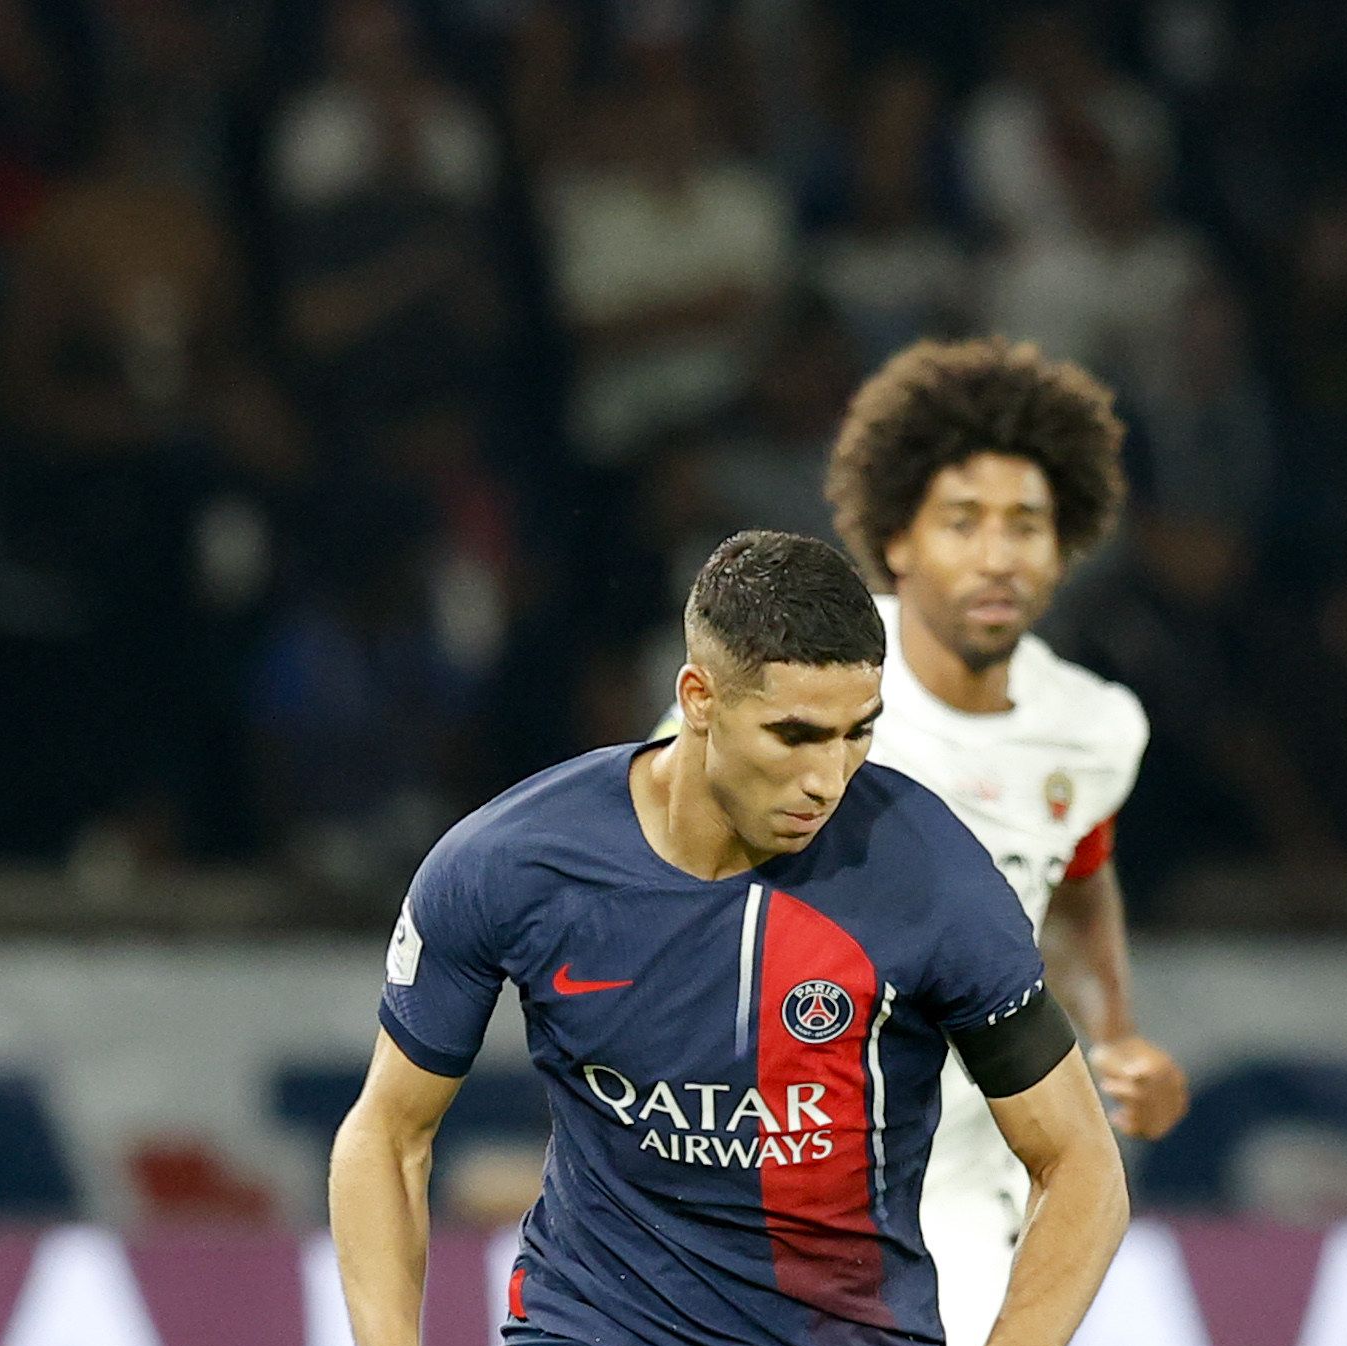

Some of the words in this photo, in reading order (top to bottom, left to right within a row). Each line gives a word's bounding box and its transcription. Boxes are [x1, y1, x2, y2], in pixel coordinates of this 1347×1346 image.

[794, 983, 841, 999] PARIS
[583, 1064, 833, 1133] QATAR
[640, 1128, 833, 1169] AIRWAYS
